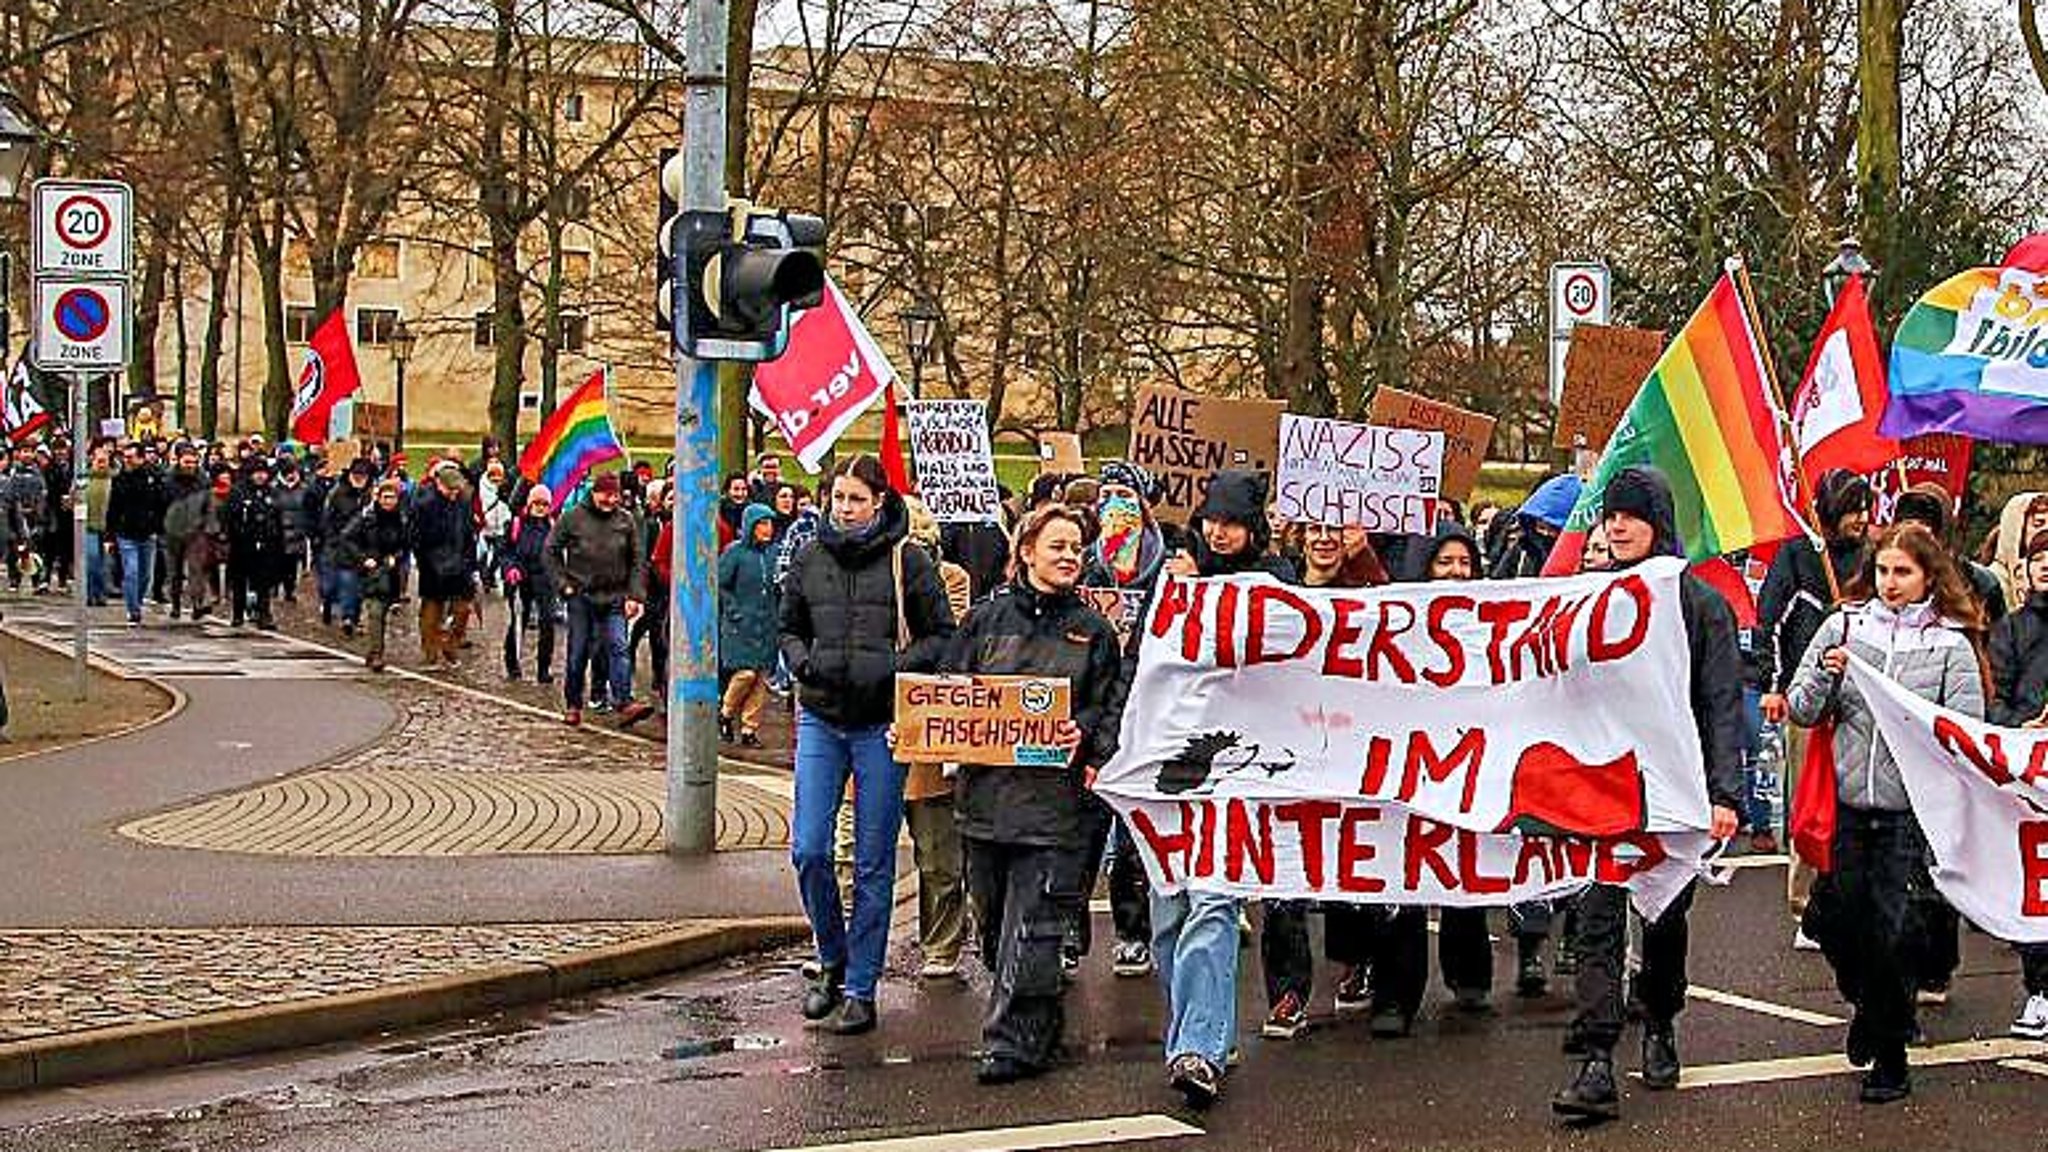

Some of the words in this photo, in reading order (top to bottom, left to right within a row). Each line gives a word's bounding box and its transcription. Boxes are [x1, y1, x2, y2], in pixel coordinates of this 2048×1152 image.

[68, 209, 99, 234] 20
[61, 252, 104, 268] ZONE
[1572, 285, 1591, 304] 20
[60, 344, 104, 360] ZONE
[1139, 394, 1200, 434] ALLE
[1134, 432, 1228, 469] HASSEN
[907, 685, 1003, 709] GEGEN
[1359, 727, 1485, 813] IM
[1130, 797, 1669, 894] HINTERLAND
